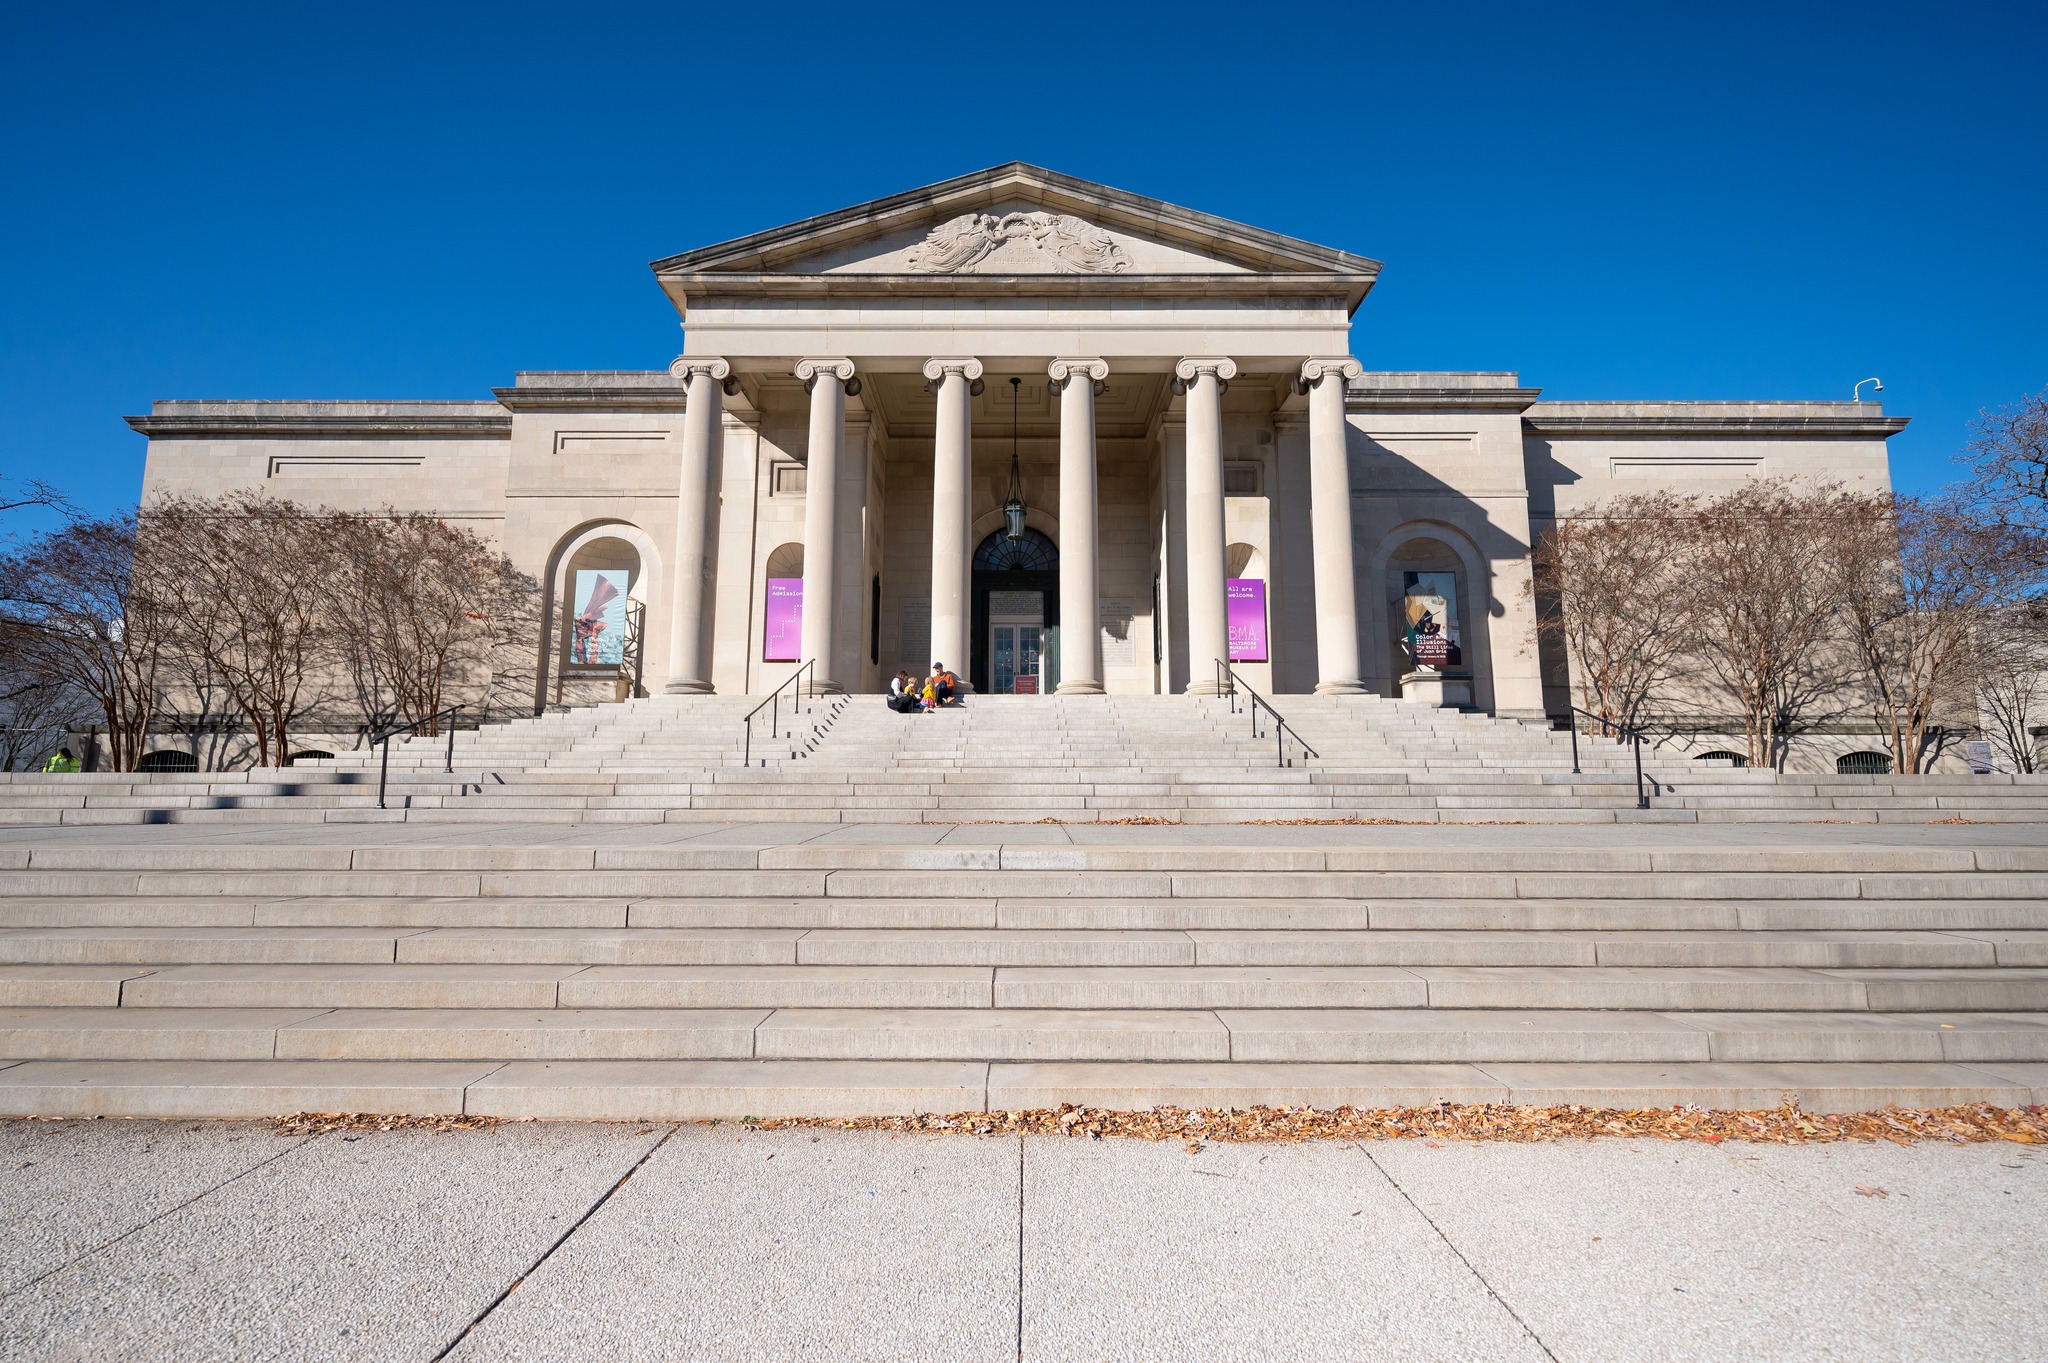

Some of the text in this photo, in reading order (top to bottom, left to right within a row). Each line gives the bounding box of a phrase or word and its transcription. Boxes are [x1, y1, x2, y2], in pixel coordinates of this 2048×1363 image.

[1003, 247, 1034, 255] TO THE
[1229, 626, 1256, 640] BMA
